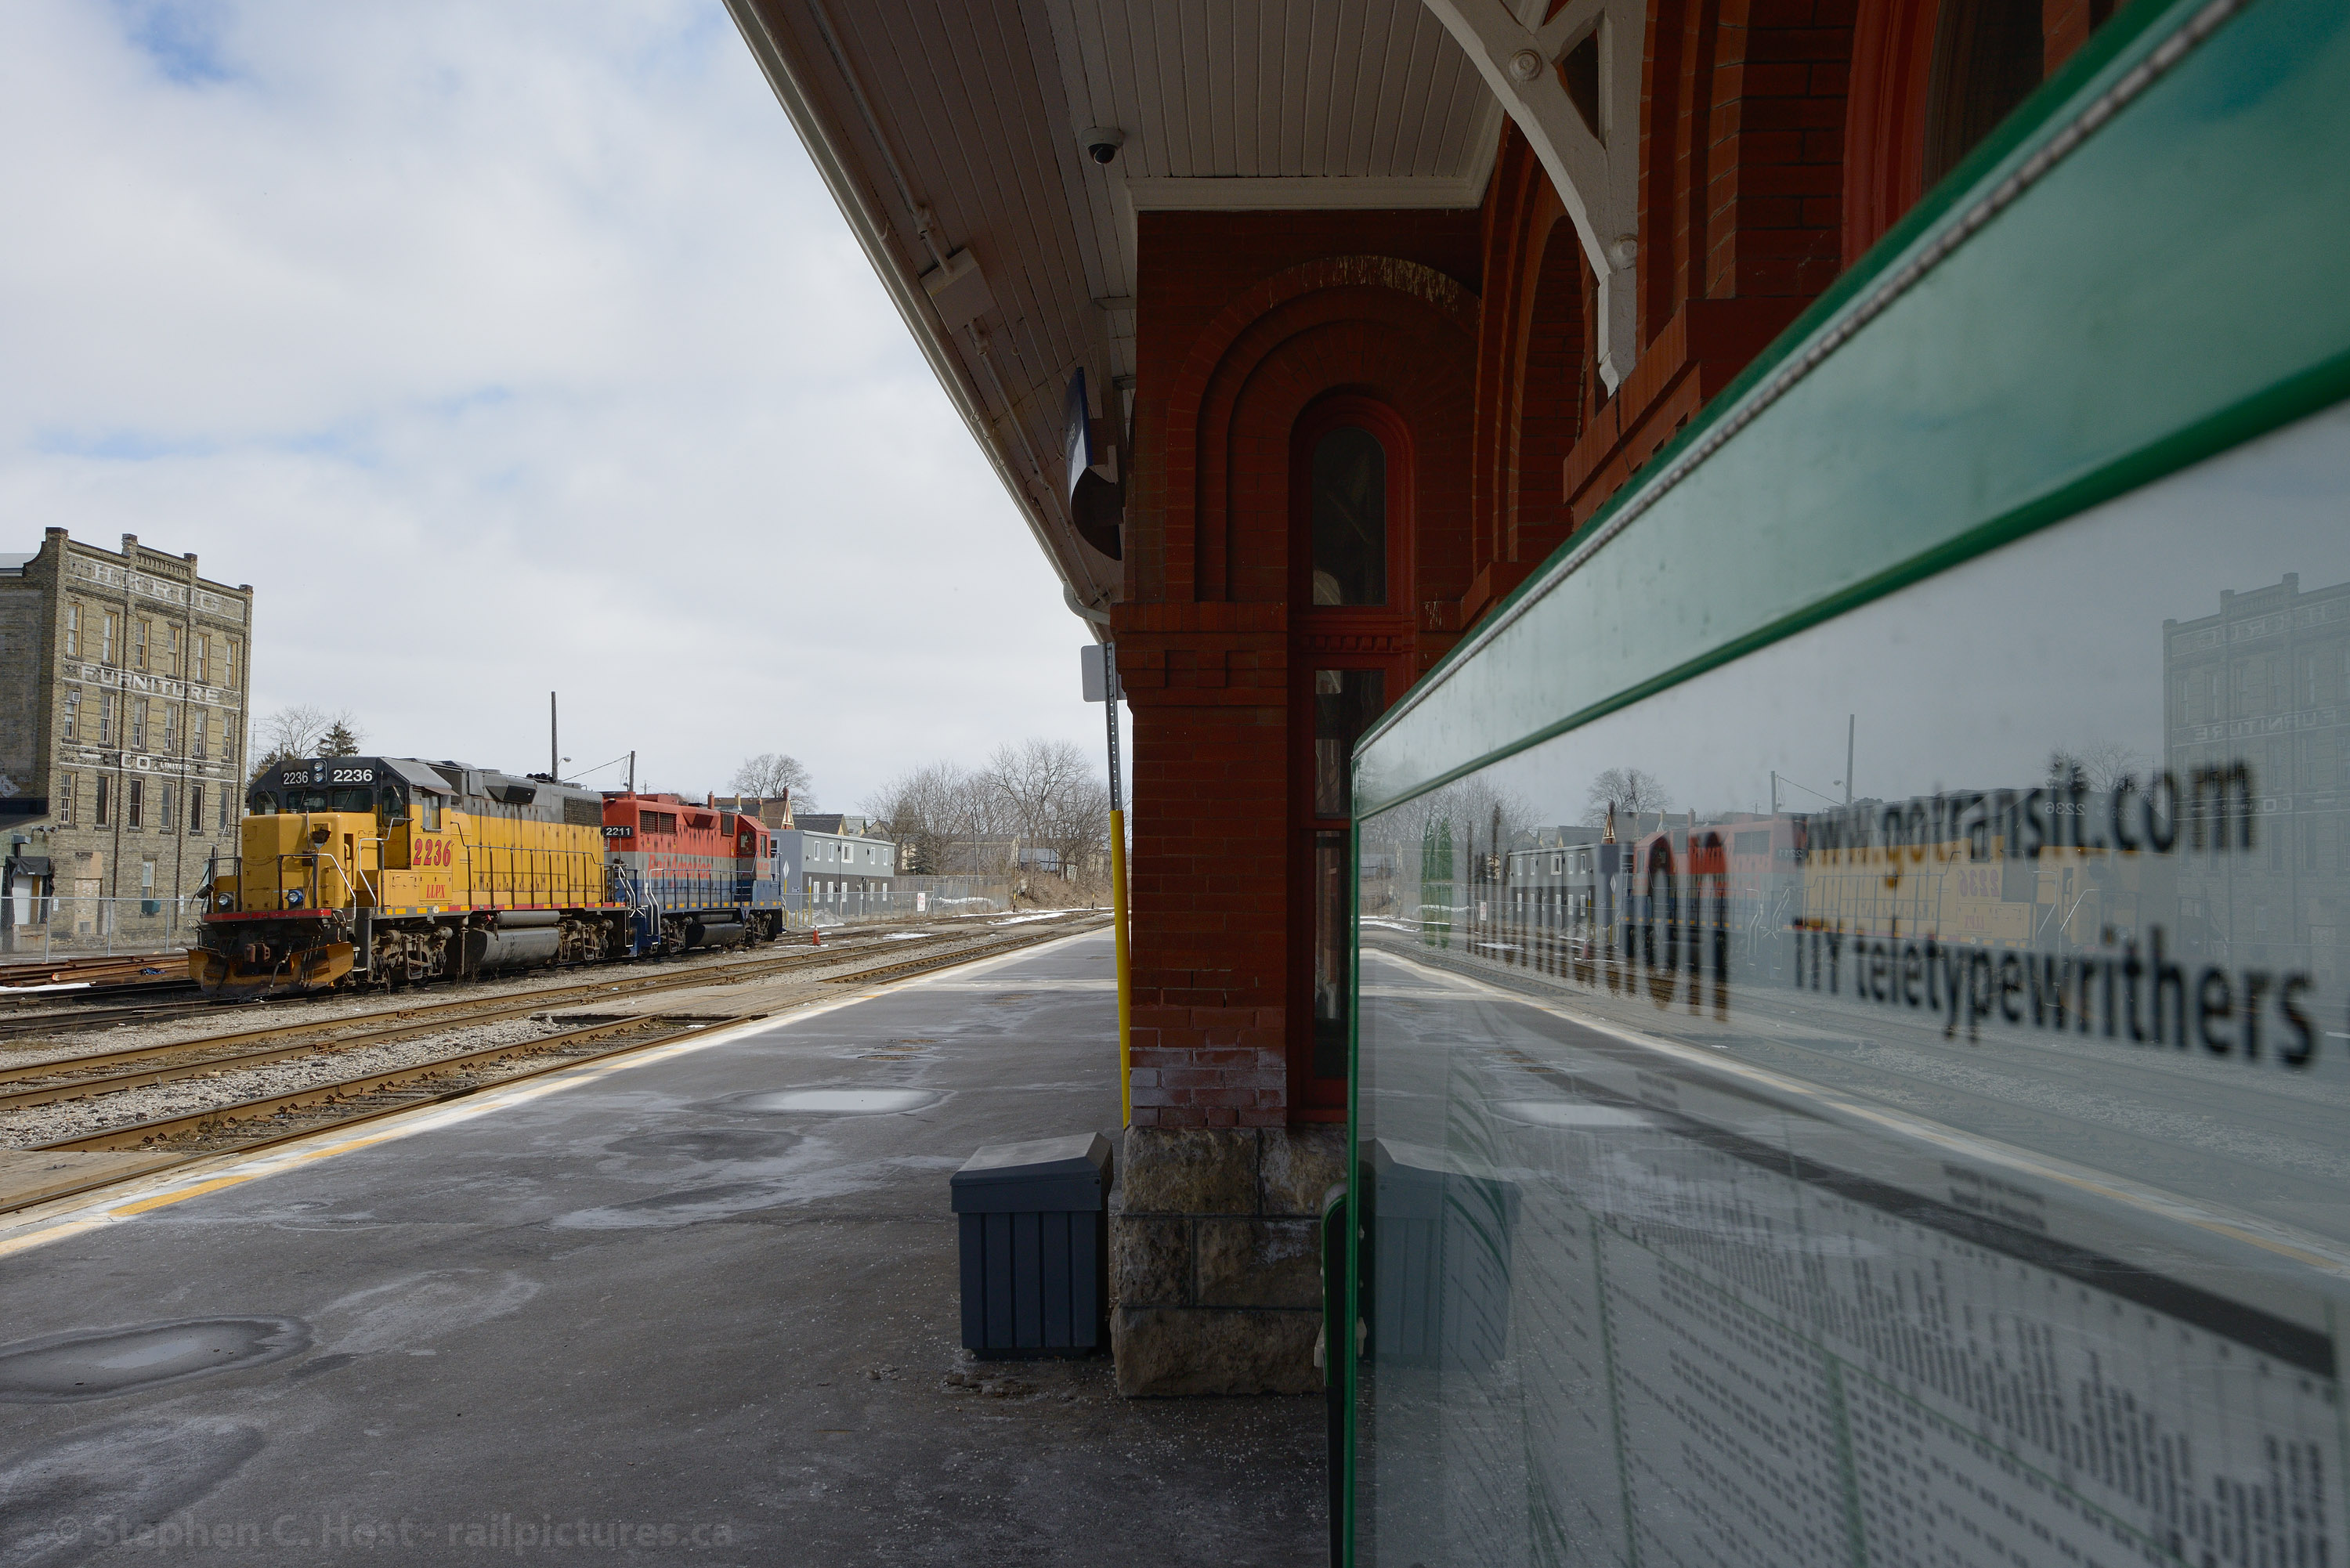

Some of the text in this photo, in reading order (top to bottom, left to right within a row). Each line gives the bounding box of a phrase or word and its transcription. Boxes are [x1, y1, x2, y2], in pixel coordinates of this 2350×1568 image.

[81, 666, 220, 703] FURNITURE
[284, 771, 309, 785] 2236
[333, 769, 373, 782] 2236
[606, 827, 631, 837] 2211
[413, 838, 451, 867] 2236
[647, 854, 713, 880] RailAmerica
[426, 883, 446, 899] LLPX
